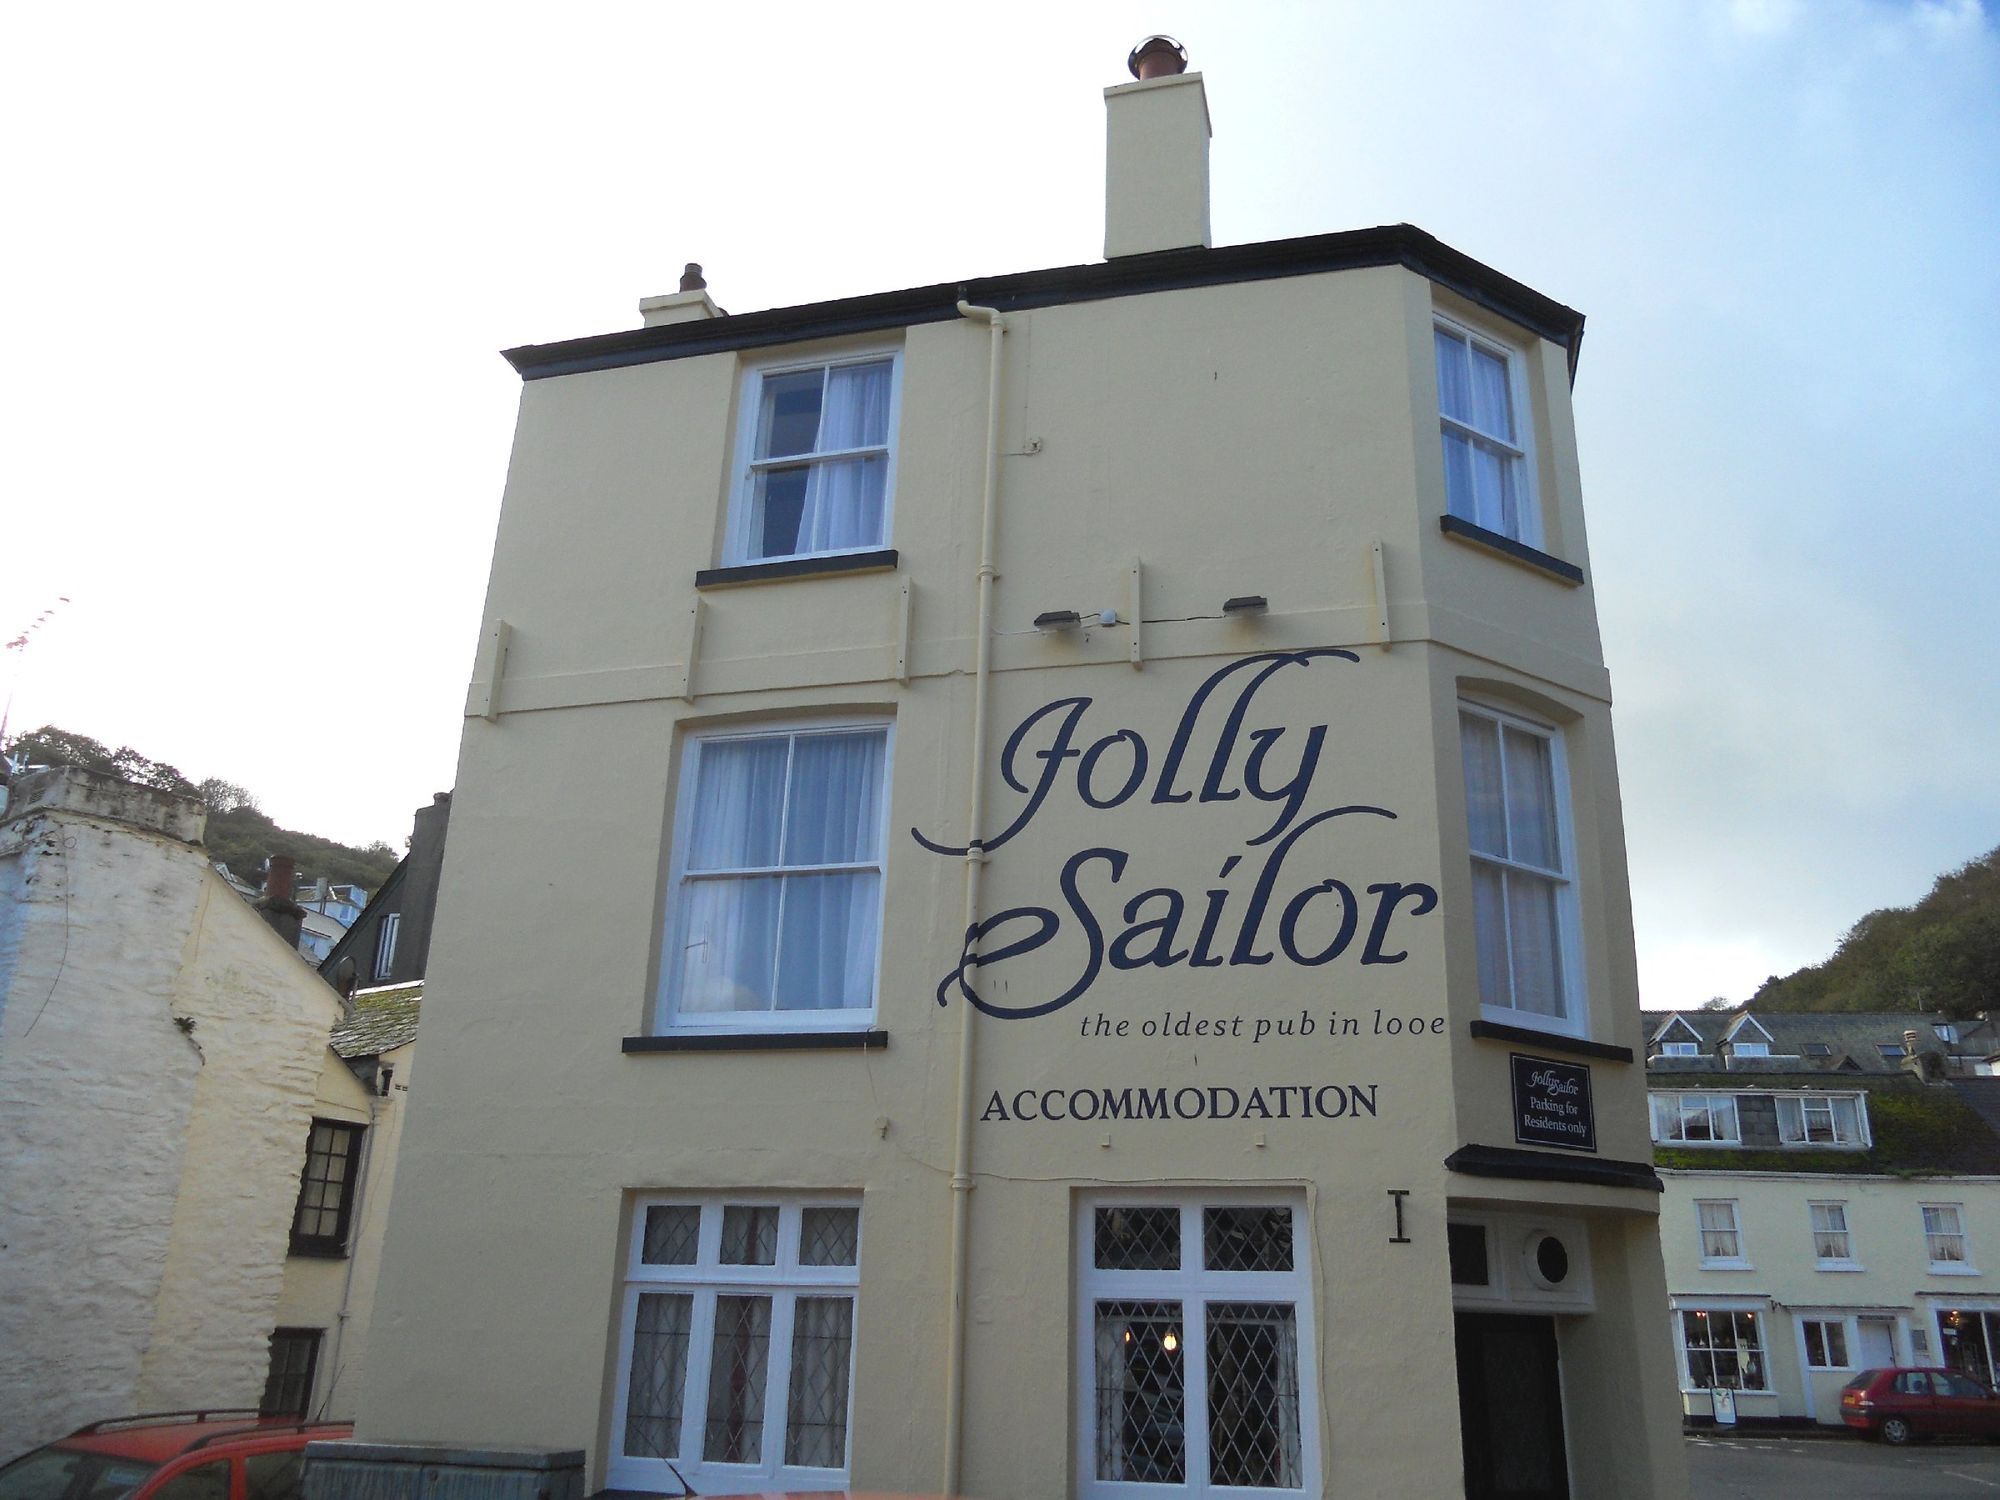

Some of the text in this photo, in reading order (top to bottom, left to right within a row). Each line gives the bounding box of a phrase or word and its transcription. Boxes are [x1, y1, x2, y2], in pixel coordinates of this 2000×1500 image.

[911, 649, 1360, 856] Jolly
[937, 806, 1438, 1020] Sailor
[1080, 1009, 1446, 1043] the oldest pub in looe
[1527, 1070, 1579, 1096] Jolly Sailor
[980, 1084, 1378, 1121] ACCOMMODATION
[1530, 1096, 1578, 1116] Parking for
[1524, 1114, 1587, 1138] Residents only
